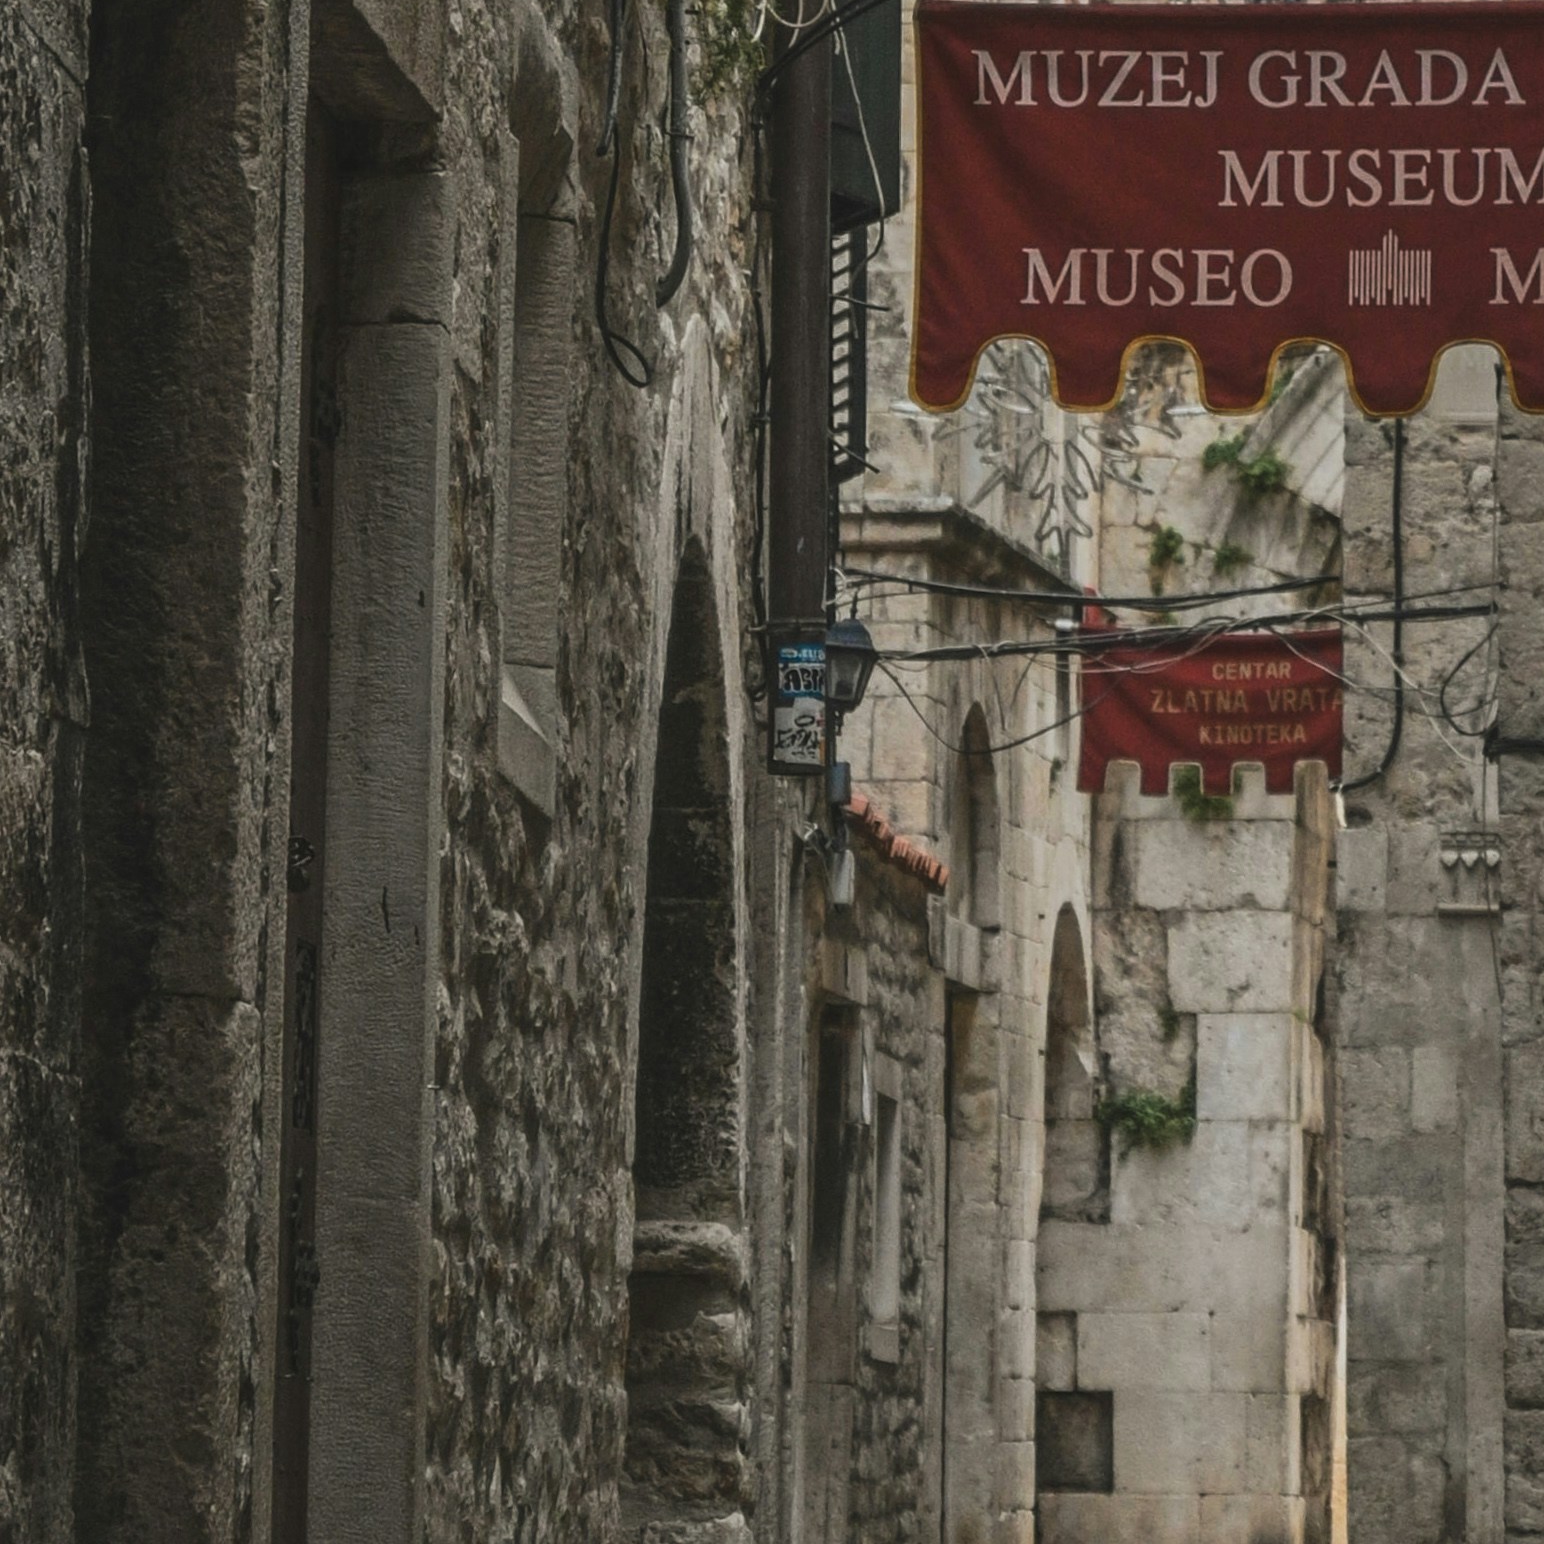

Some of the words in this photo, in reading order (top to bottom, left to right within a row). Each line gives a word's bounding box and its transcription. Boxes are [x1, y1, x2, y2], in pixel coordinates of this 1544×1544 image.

[970, 48, 1224, 108] MUZEJ
[1247, 47, 1526, 108] GRADA
[1019, 247, 1294, 307] MUSEO
[1211, 661, 1292, 681] CENTAR
[1150, 688, 1249, 715] ZLATNA
[1266, 686, 1344, 713] VRATA
[1199, 723, 1307, 745] KINOTEKA
